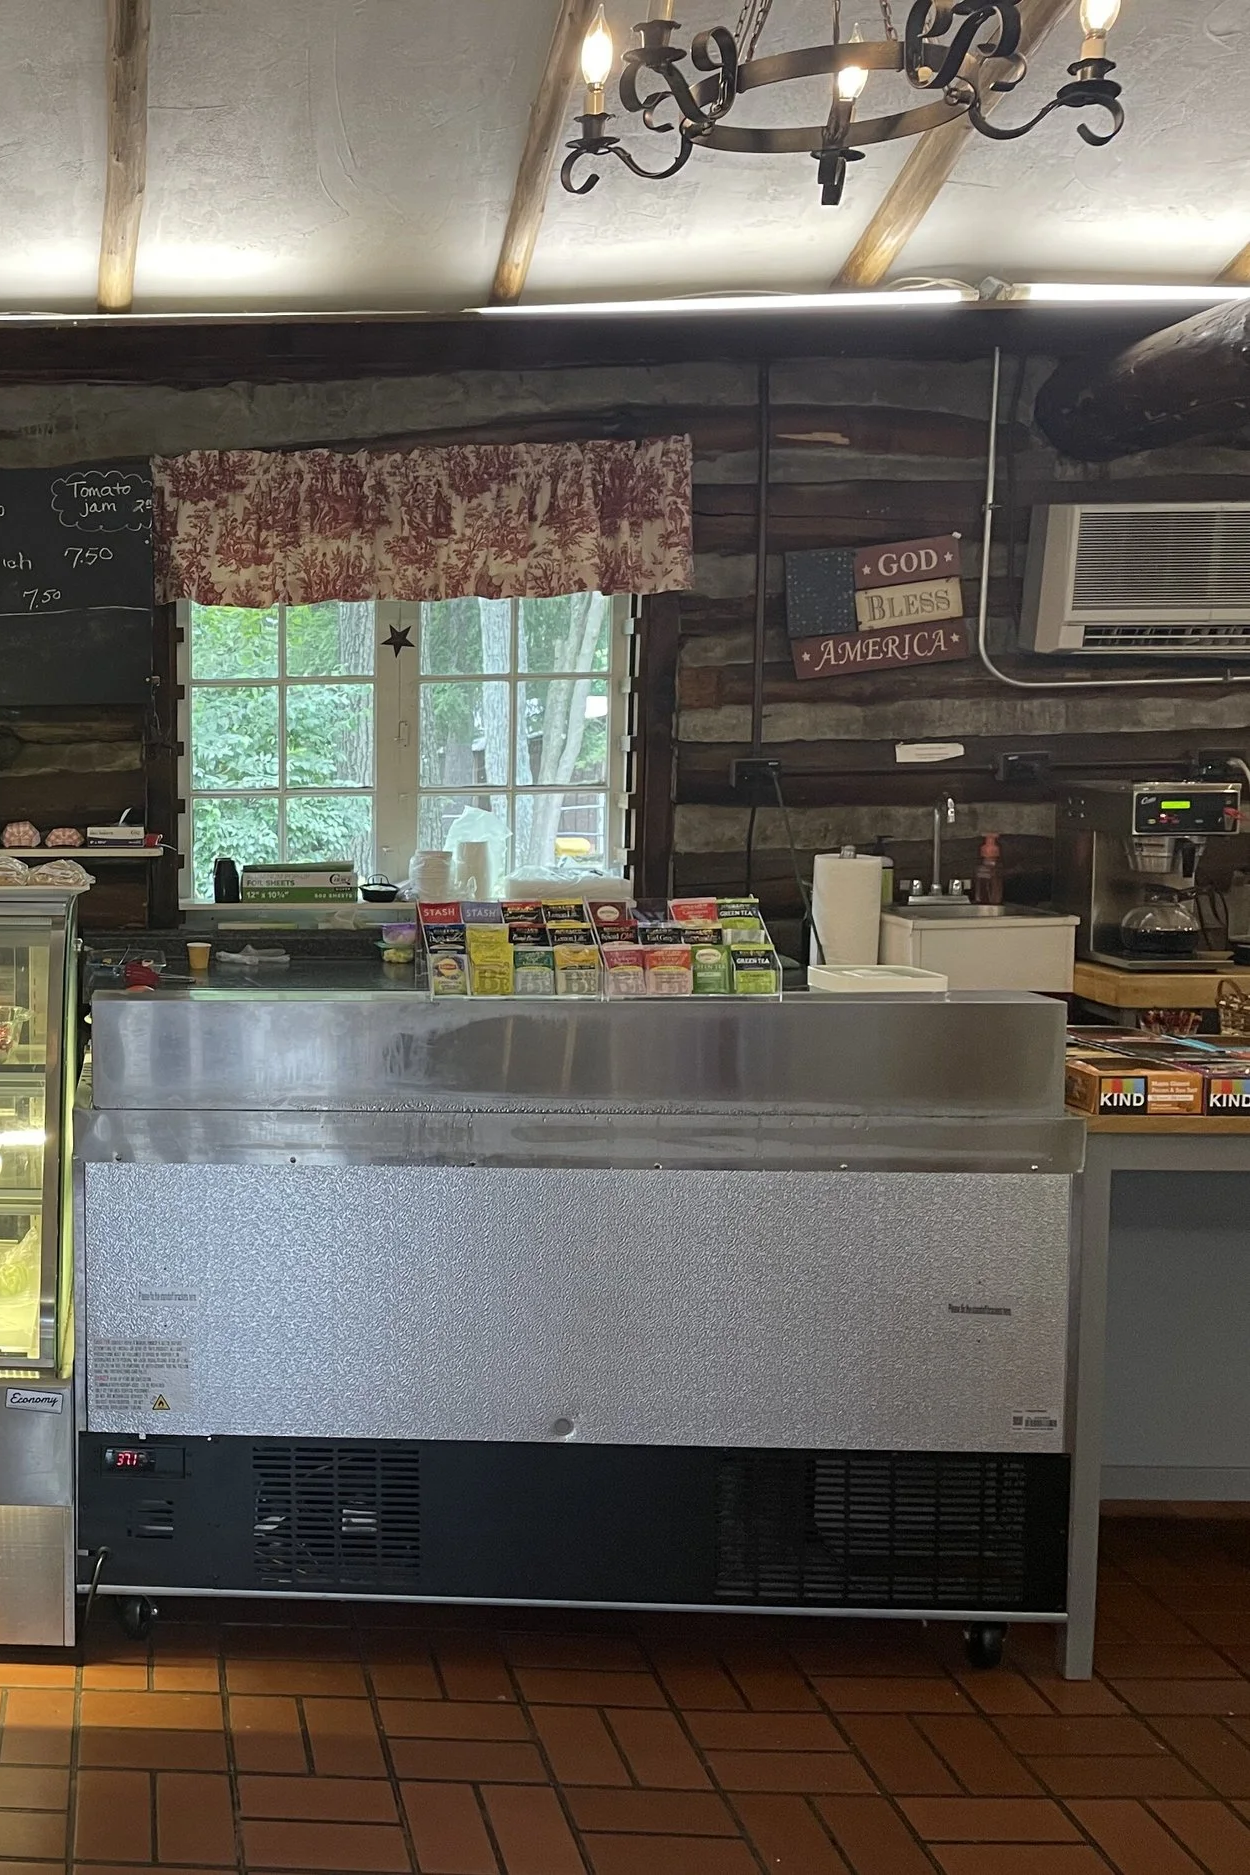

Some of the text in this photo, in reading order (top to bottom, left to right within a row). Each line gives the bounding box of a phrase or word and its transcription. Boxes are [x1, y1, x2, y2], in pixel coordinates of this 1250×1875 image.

[66, 481, 131, 498] Tomato
[79, 502, 117, 517] jam
[64, 547, 114, 568] 7.50
[878, 549, 938, 577] GOD
[22, 588, 62, 611] 7.50
[865, 588, 951, 622] BLESS
[814, 629, 948, 671] AMERICA
[246, 879, 263, 887] FOIL
[423, 907, 455, 917] STASH
[466, 908, 496, 917] STASH
[1100, 1093, 1145, 1106] KIND
[1209, 1093, 1250, 1107] KIND
[10, 1392, 59, 1407] Economy
